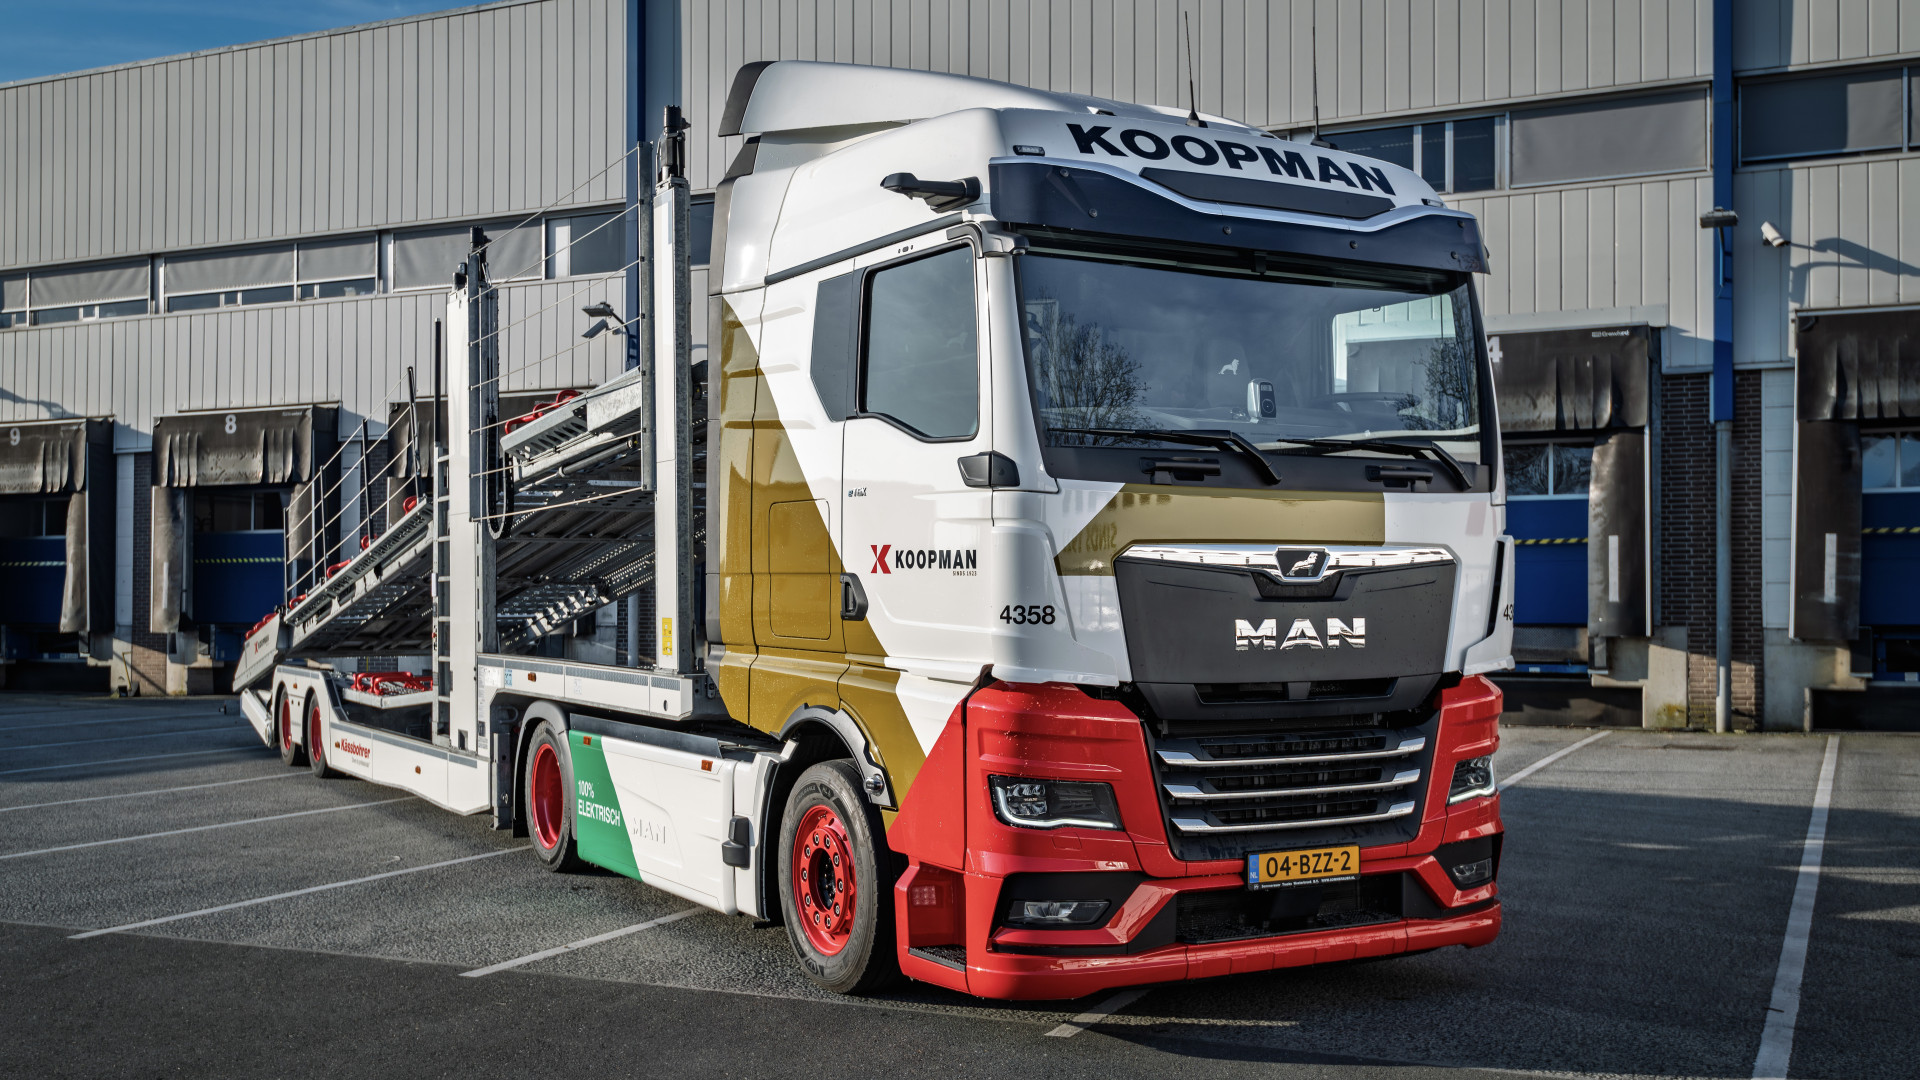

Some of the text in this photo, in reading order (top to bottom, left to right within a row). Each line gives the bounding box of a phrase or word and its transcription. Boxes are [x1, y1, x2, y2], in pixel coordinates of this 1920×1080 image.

[1066, 123, 1397, 196] KOOPMAN
[1488, 336, 1503, 363] 4
[224, 414, 237, 434] 8
[9, 428, 21, 446] 9
[895, 549, 977, 569] KOOPMAN
[999, 605, 1056, 625] 4358
[1234, 617, 1366, 651] MAN
[578, 780, 595, 799] 100%
[578, 799, 621, 827] ELEKTRISCH
[1249, 850, 1351, 879] NL 04-BZZ-2
